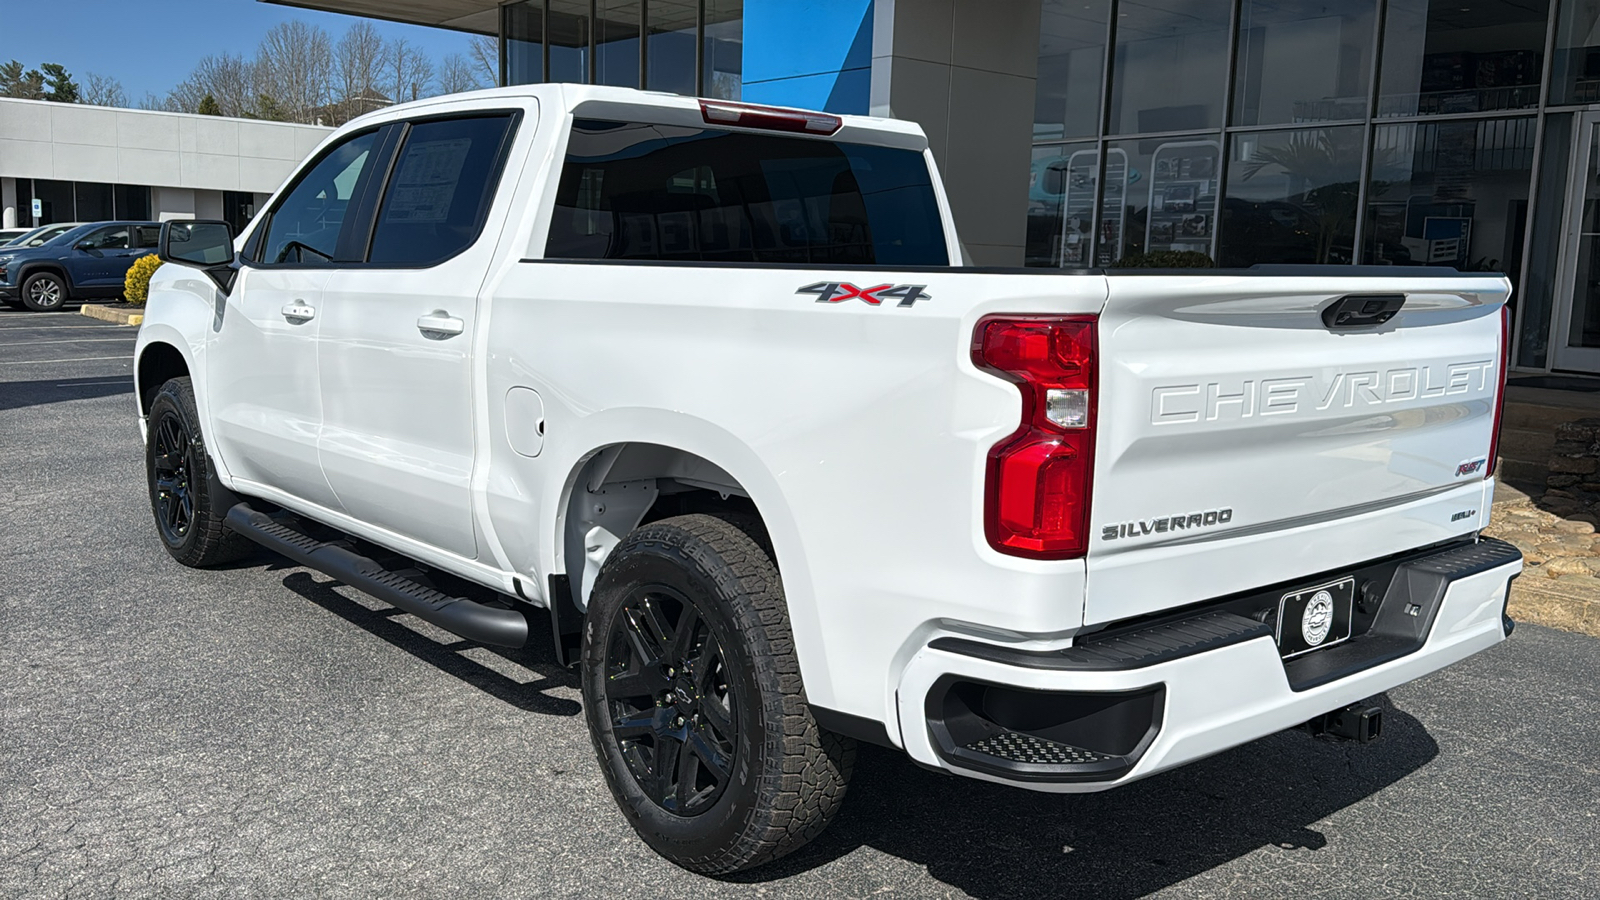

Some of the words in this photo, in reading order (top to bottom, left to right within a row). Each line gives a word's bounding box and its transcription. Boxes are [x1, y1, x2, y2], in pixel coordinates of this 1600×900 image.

[1151, 360, 1493, 425] CHEVROLET
[1455, 459, 1486, 477] RST
[1101, 507, 1233, 540] SILVERADO
